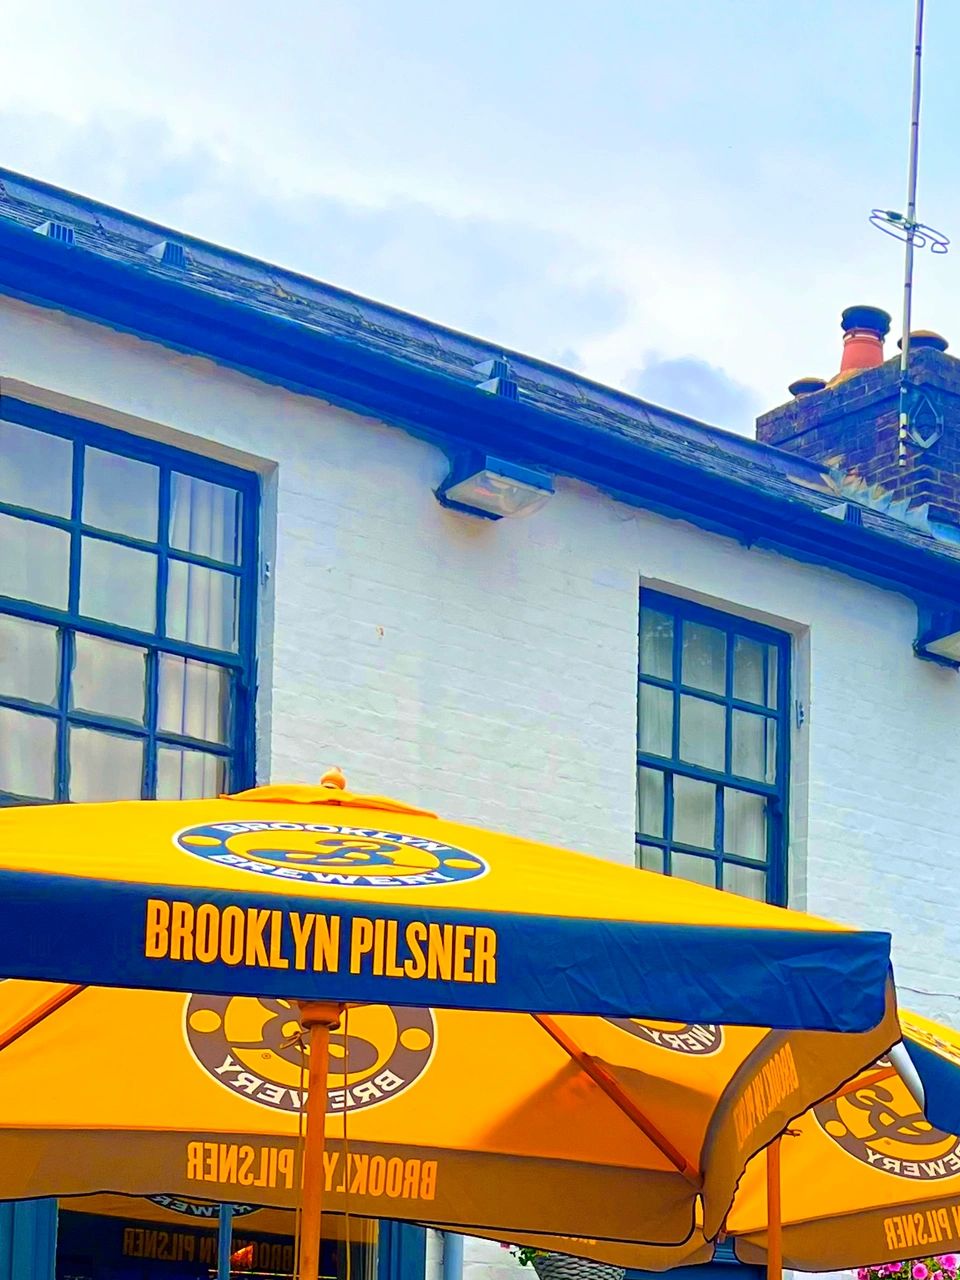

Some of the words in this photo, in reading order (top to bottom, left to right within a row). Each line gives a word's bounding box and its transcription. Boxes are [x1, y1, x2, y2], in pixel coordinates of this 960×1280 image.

[215, 821, 453, 852] BROOKLYN
[208, 854, 456, 887] BREWERY
[145, 899, 341, 973] BROOKLYN
[349, 916, 497, 984] PILSNER
